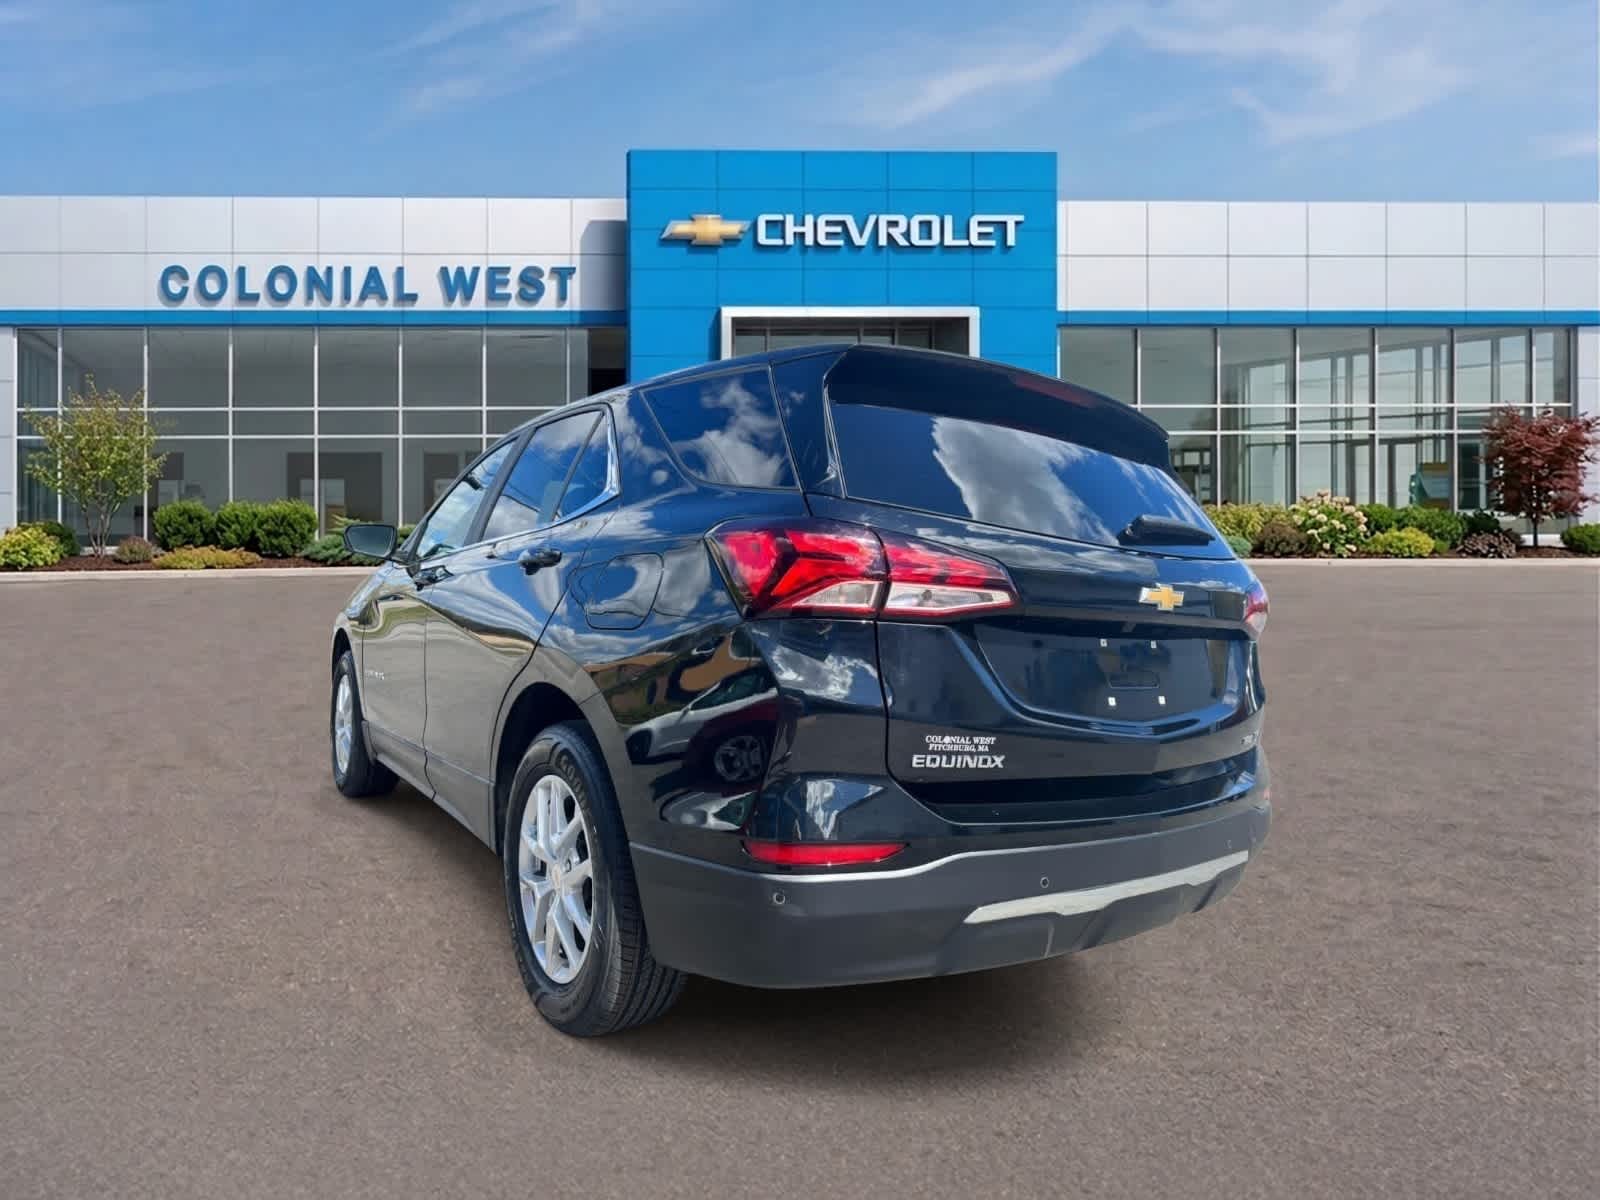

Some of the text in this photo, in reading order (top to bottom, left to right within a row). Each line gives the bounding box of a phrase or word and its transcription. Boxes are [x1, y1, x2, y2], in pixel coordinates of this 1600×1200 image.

[757, 214, 1025, 246] CHEVROLET
[160, 264, 577, 303] COLONIAL WEST
[928, 743, 989, 752] FITCHBURG, MA
[972, 736, 996, 745] WEST
[911, 754, 1005, 768] EQUINOX
